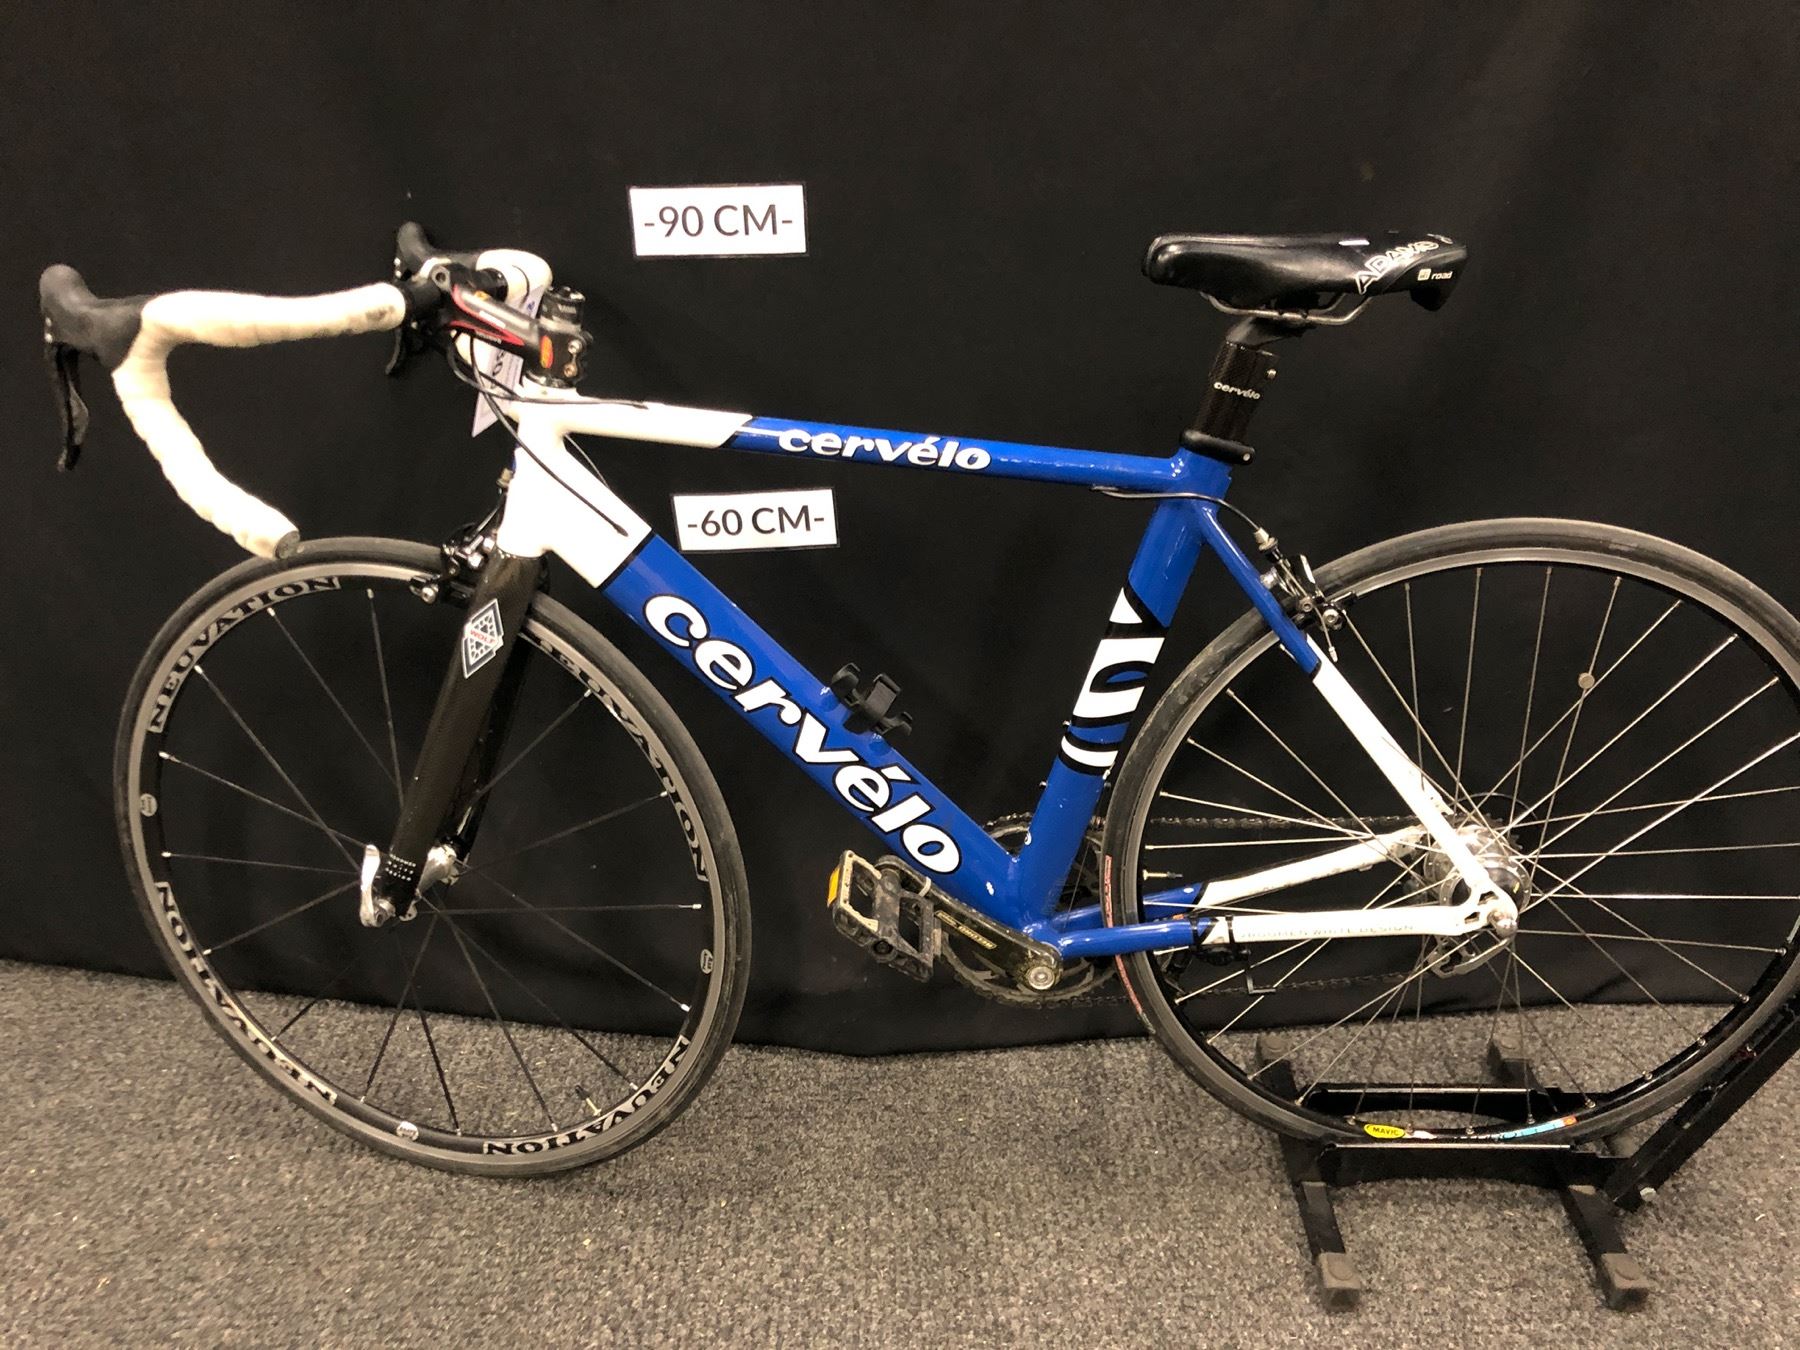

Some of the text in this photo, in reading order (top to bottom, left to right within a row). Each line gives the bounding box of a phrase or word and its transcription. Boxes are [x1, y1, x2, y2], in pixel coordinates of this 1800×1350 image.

[644, 204, 792, 237] -90 CM-
[1431, 271, 1453, 279] road
[779, 429, 992, 470] cervélo
[687, 505, 825, 537] -60 CM-
[150, 576, 341, 729] NEUVATION
[644, 595, 961, 874] cervélo
[485, 1040, 690, 1156] NEUVATION
[1372, 1127, 1399, 1136] MAVIC
